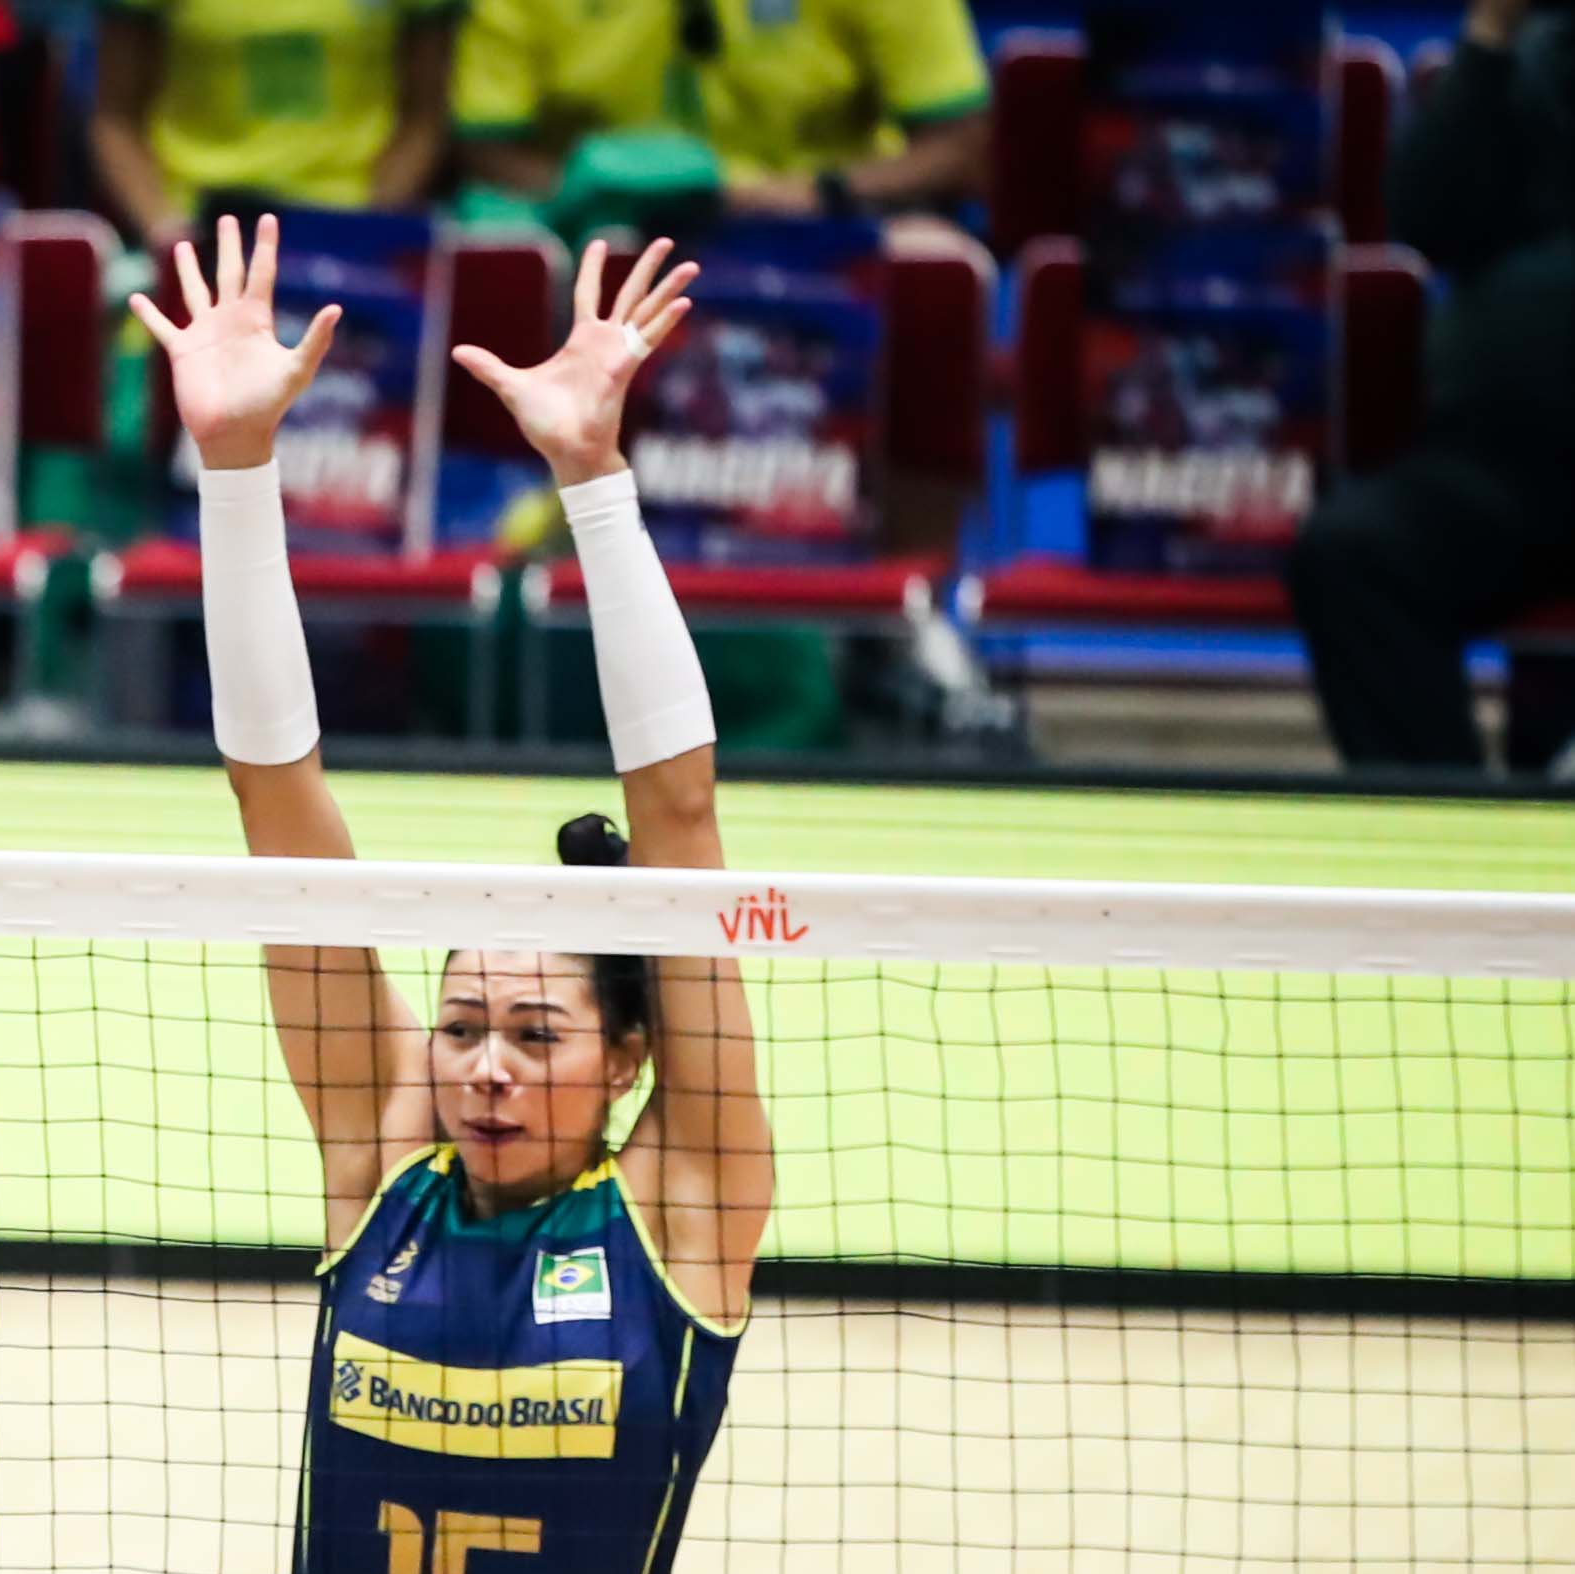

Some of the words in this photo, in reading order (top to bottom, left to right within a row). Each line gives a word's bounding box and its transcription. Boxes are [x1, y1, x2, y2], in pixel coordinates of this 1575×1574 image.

[718, 887, 809, 943] VNL
[370, 1375, 461, 1425] BANCO
[467, 1402, 503, 1428] DO
[509, 1397, 607, 1427] BRASIL
